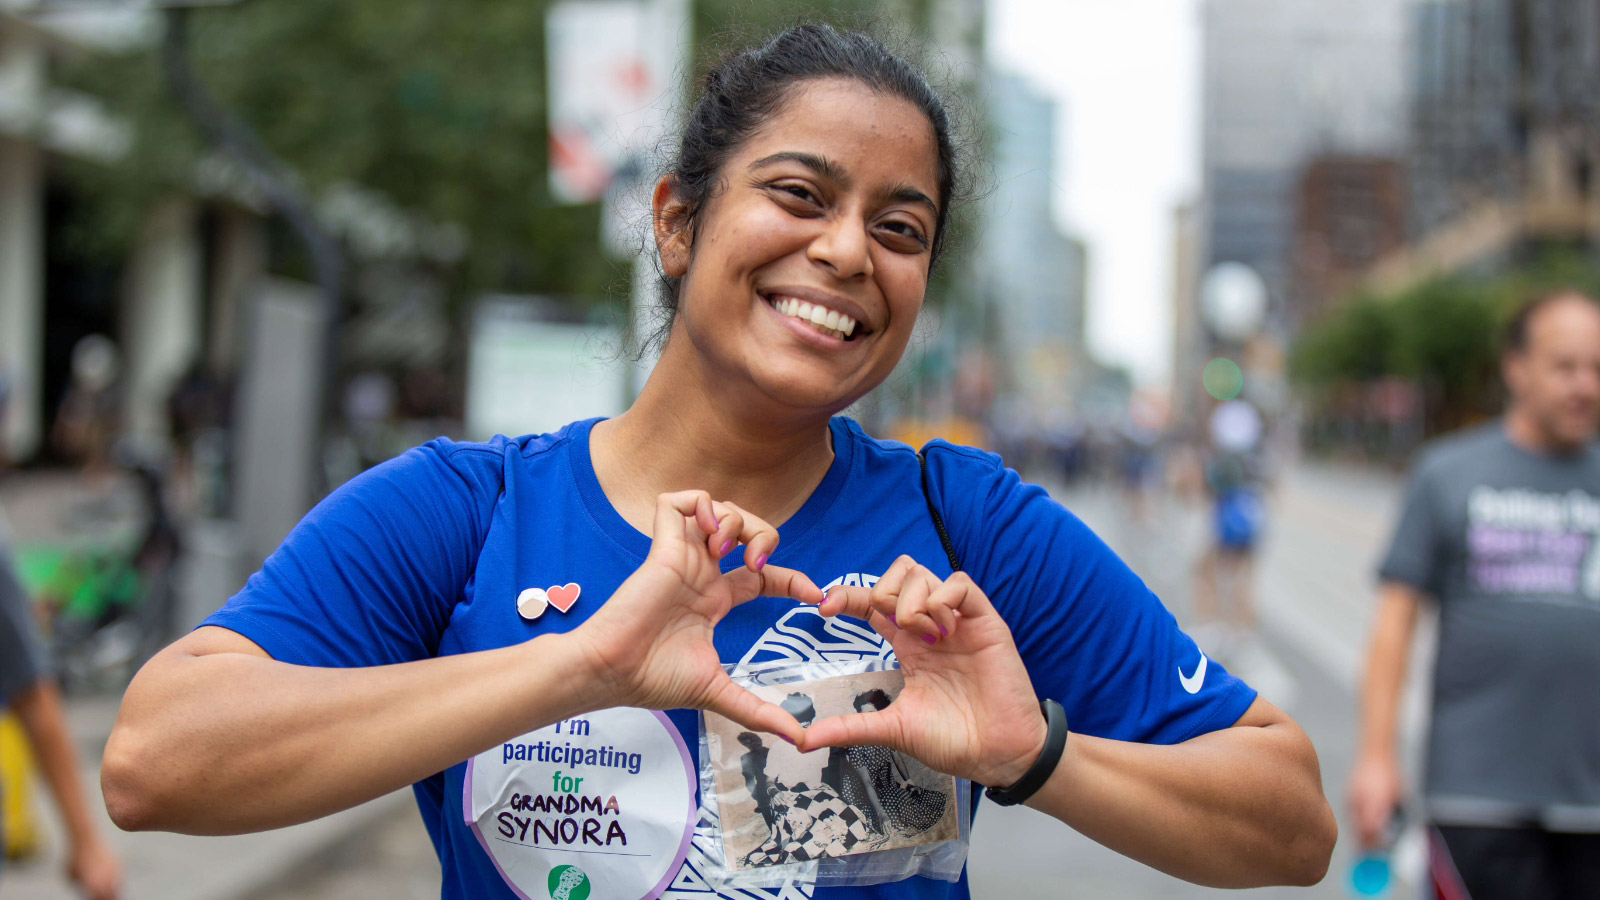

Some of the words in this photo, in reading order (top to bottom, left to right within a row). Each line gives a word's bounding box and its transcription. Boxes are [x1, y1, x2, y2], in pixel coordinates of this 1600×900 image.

[503, 741, 642, 774] participating
[552, 771, 584, 794] for
[510, 793, 620, 816] GRANDMA
[497, 811, 627, 846] SYNORA
